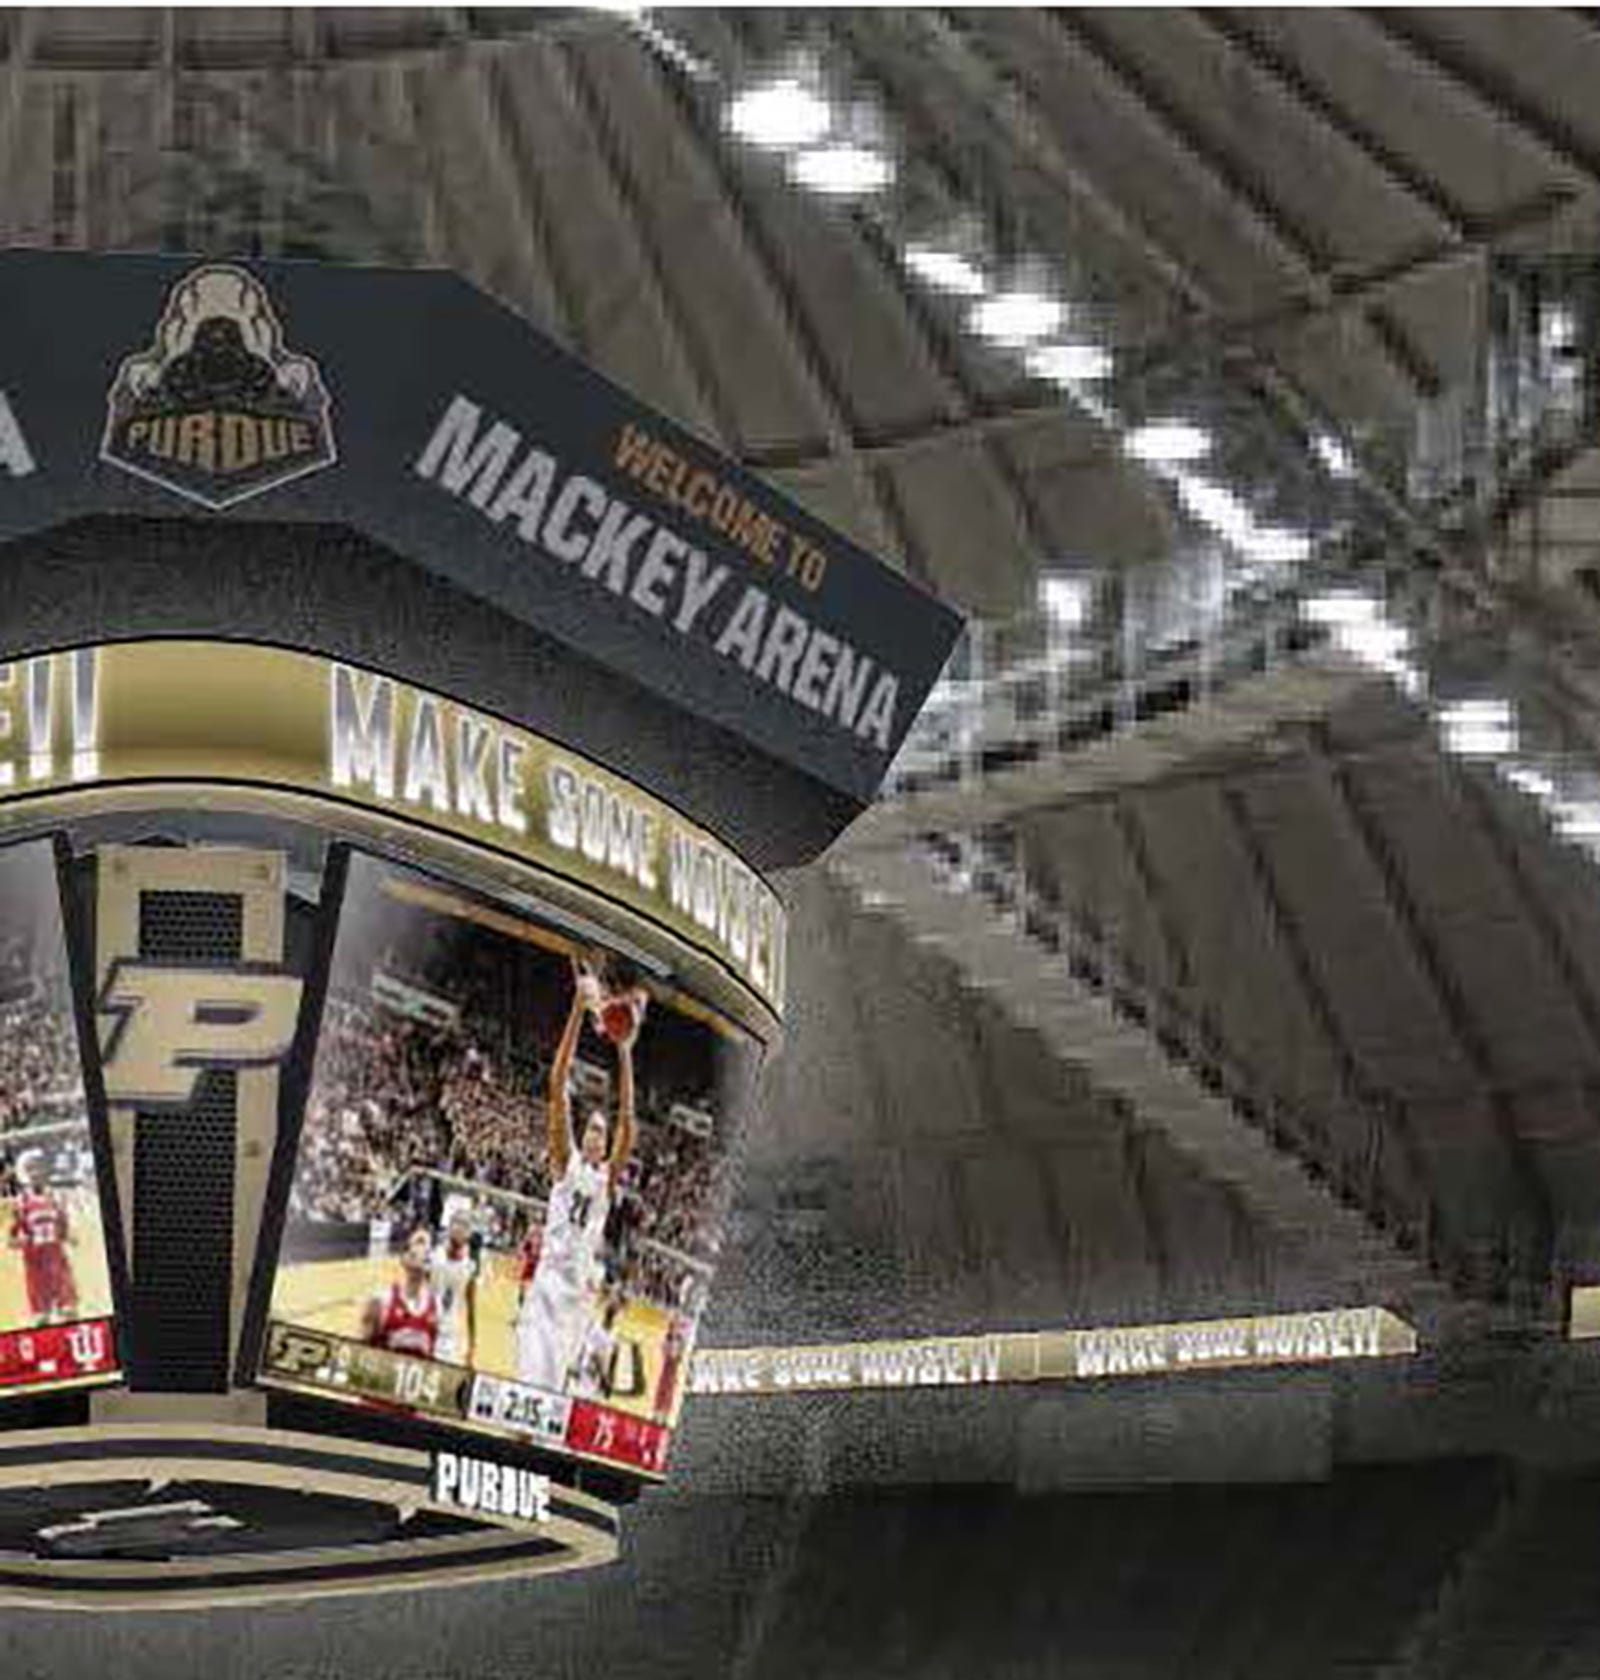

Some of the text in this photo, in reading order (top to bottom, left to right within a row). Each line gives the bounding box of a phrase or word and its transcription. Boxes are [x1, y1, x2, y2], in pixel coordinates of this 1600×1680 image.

[127, 410, 316, 473] PURDUE
[613, 422, 830, 592] WELCOME TO
[415, 394, 902, 750] MACKEY ARENA
[330, 660, 528, 833] MAKE
[546, 762, 659, 890] SOME
[437, 1451, 552, 1522] PURDUE
